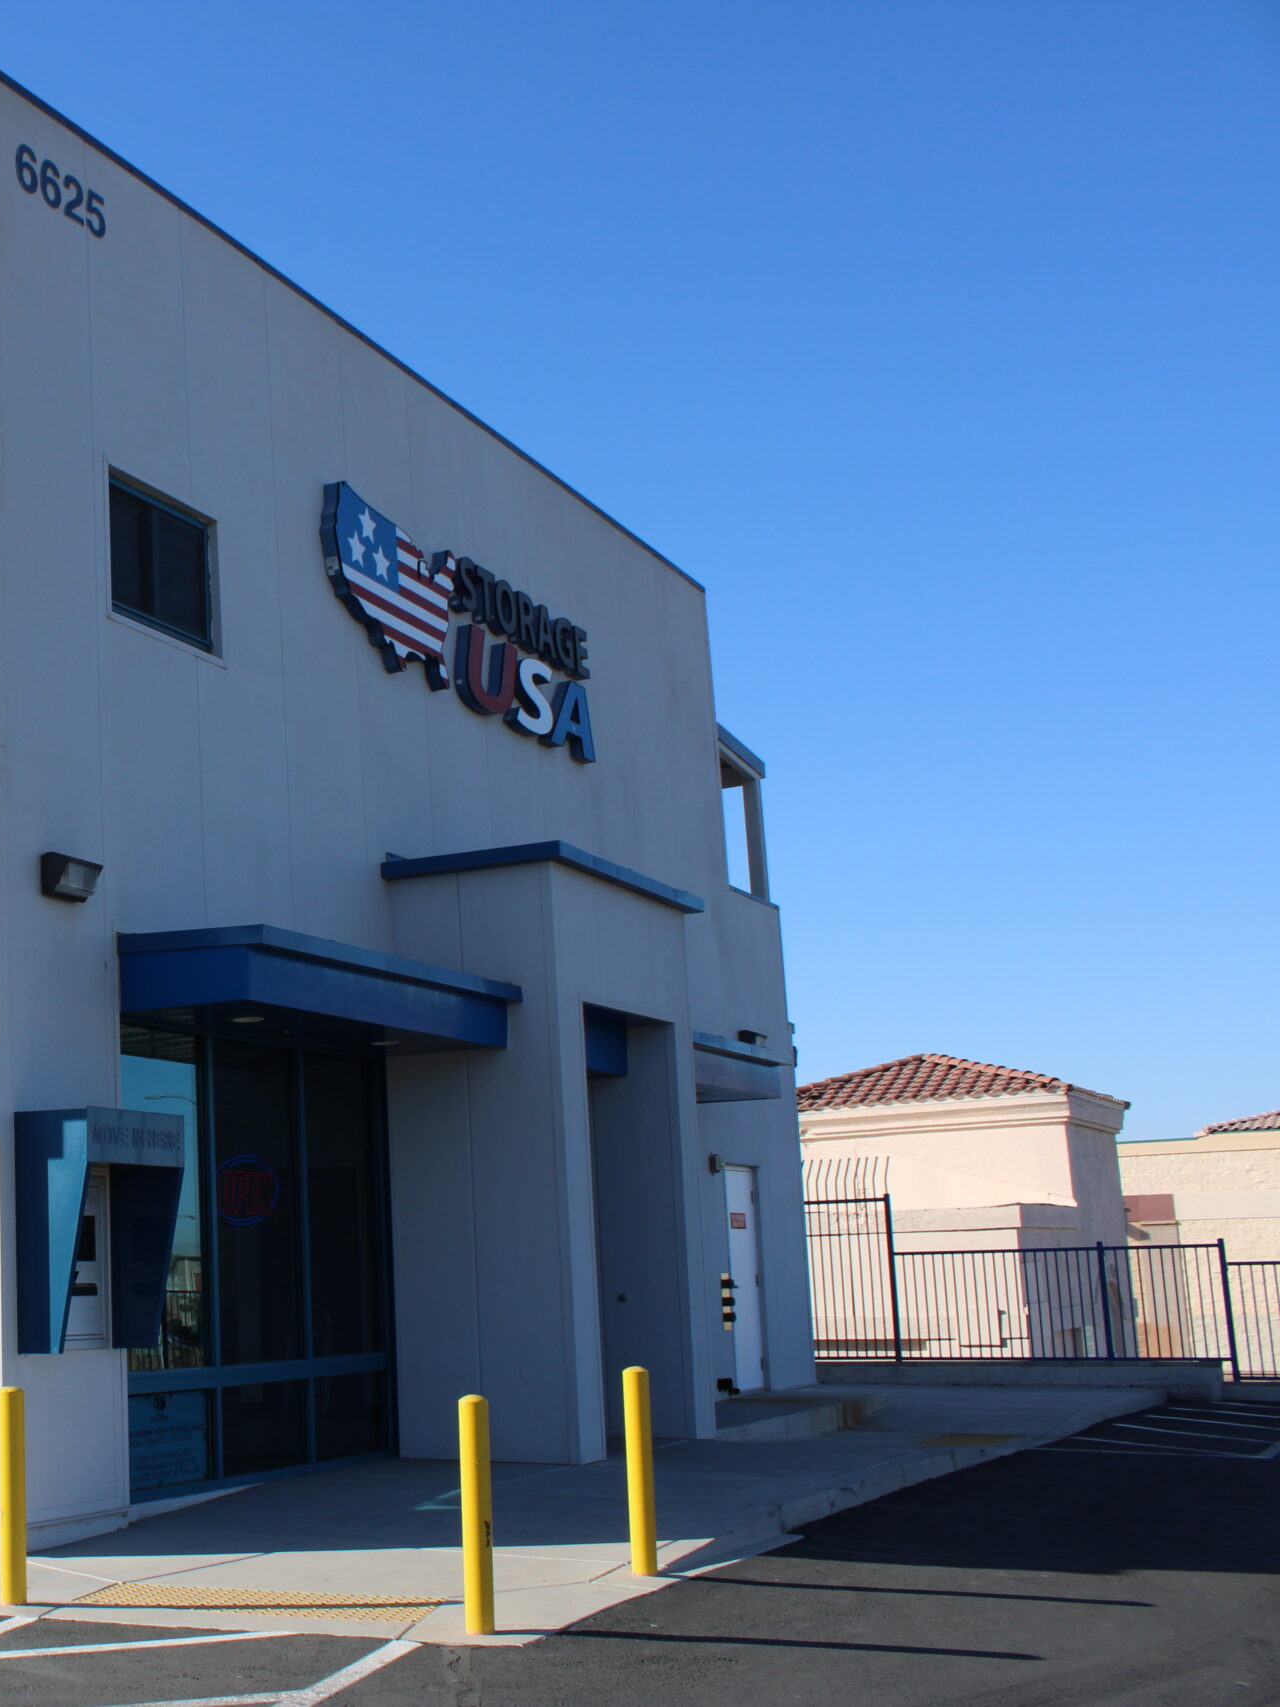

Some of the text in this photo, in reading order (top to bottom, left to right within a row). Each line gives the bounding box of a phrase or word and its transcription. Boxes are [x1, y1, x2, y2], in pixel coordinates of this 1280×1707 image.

[15, 143, 106, 239] 6625
[456, 556, 590, 681] STORAGE
[456, 624, 596, 764] USA
[92, 1125, 180, 1151] MOVE IN HERE
[219, 1169, 273, 1215] OPEN
